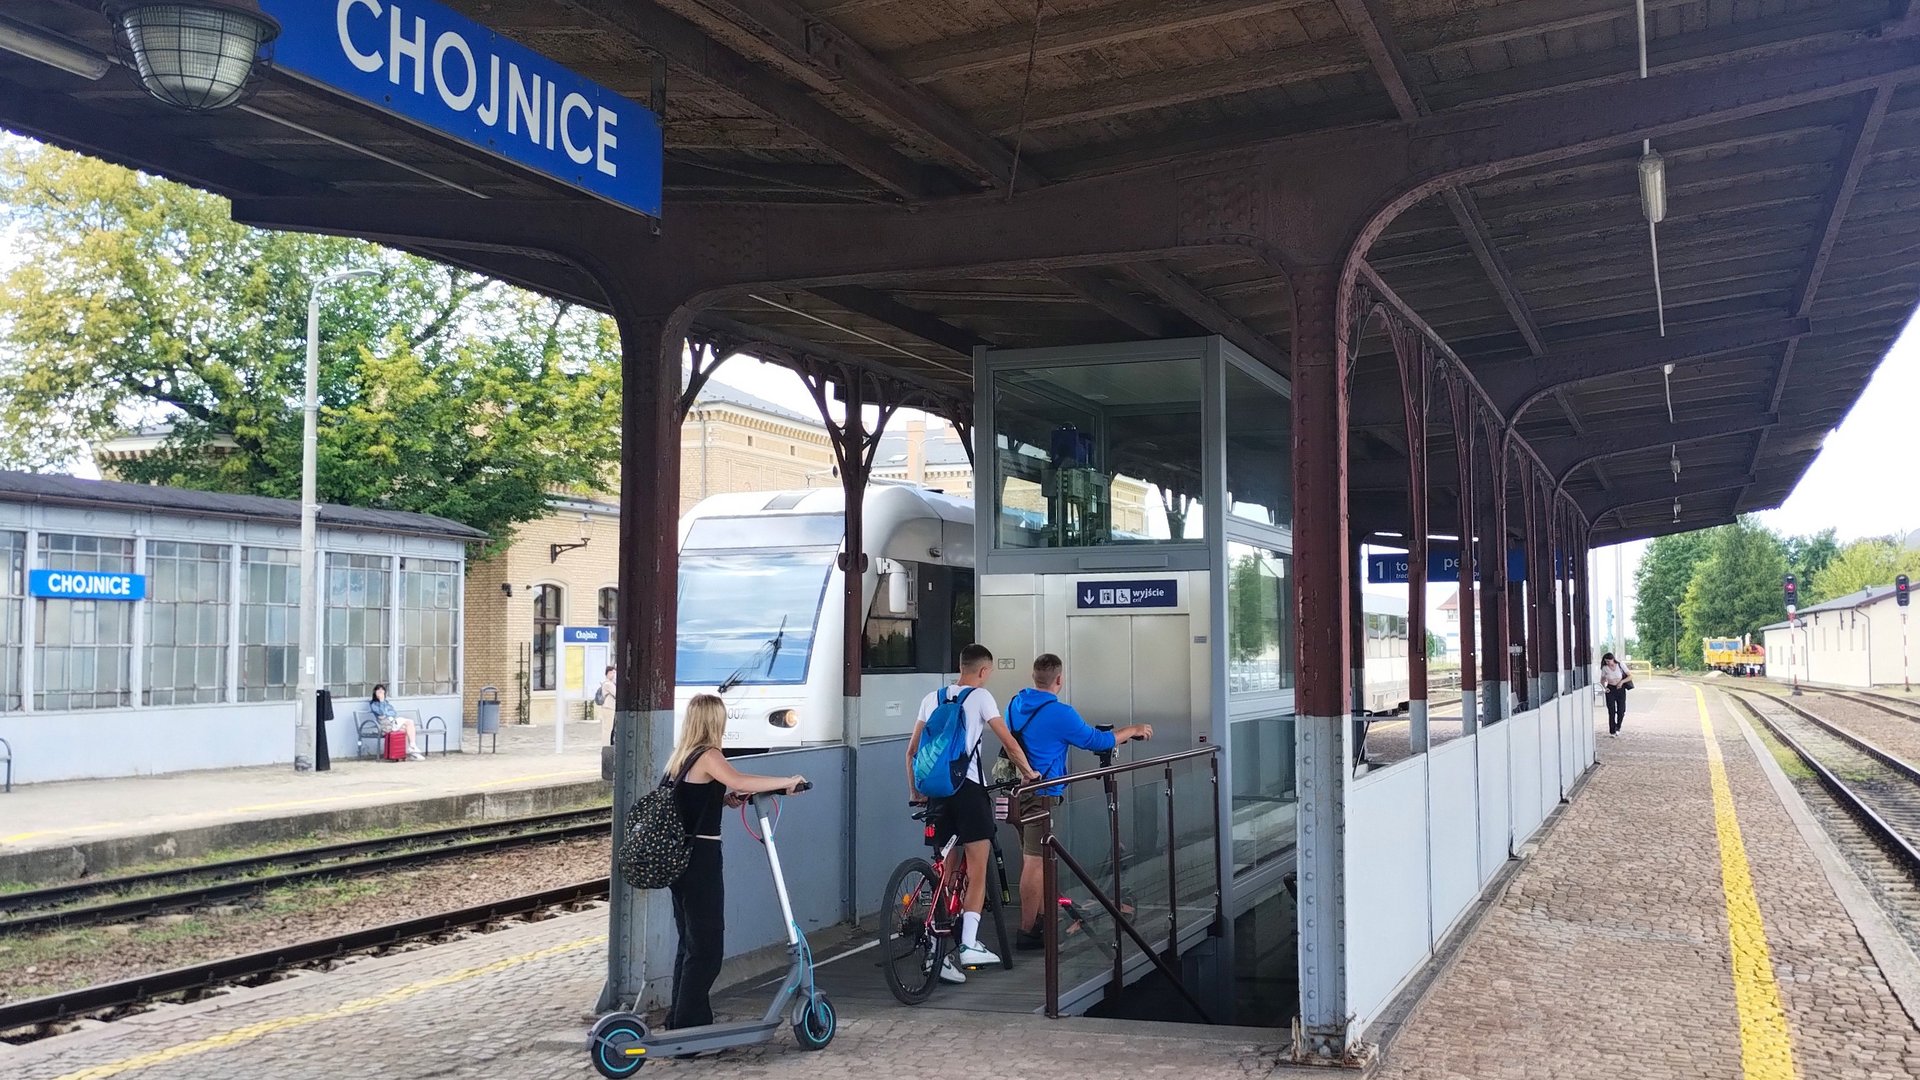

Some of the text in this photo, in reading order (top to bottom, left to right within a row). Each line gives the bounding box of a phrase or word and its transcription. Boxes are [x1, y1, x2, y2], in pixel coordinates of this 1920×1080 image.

[337, 0, 618, 177] CHOJNICE
[1375, 562, 1384, 579] 1
[1396, 561, 1409, 571] to
[48, 573, 131, 595] CHOJNICE
[1132, 588, 1165, 599] wyjście
